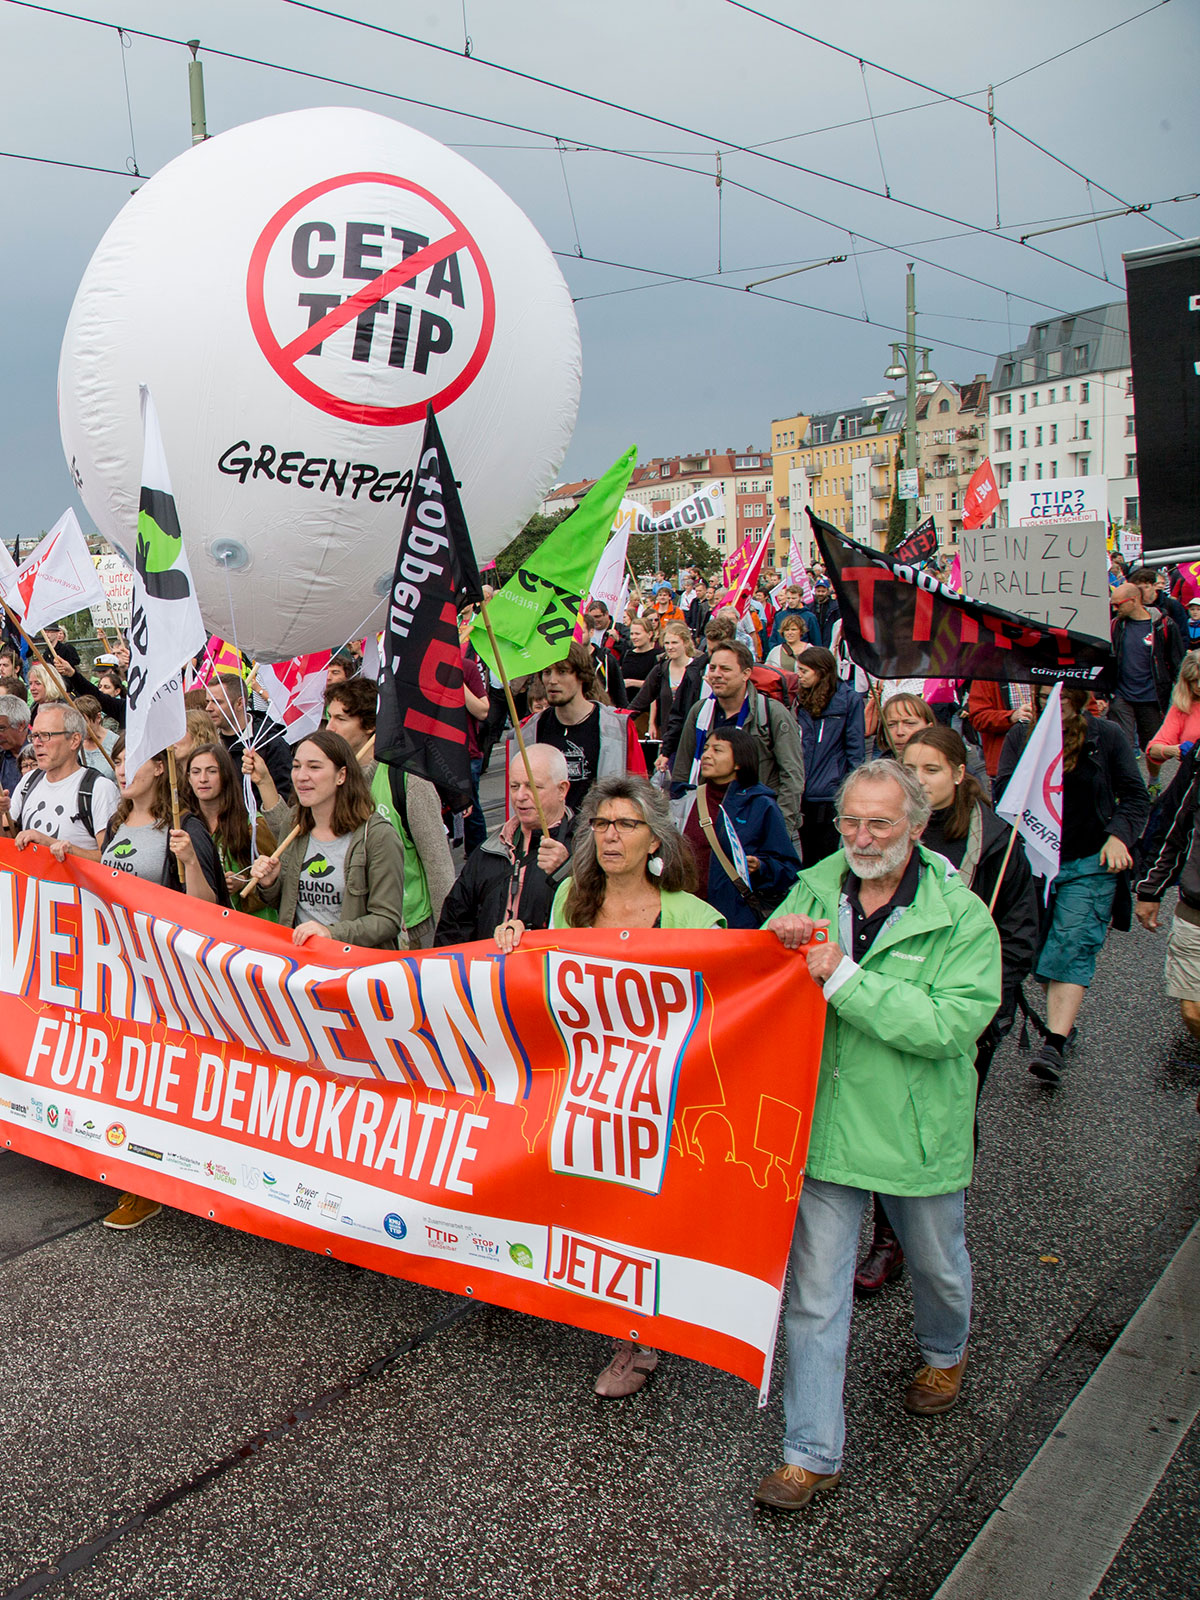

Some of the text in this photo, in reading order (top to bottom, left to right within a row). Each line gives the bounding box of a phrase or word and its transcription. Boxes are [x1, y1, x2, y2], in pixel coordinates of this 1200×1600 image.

[291, 221, 466, 310] CETA
[297, 293, 454, 375] TTIP
[217, 440, 462, 508] GREENPEA
[1030, 489, 1085, 505] TTIP?
[1030, 503, 1085, 518] CETA?
[963, 533, 1089, 563] NEIN ZU
[964, 570, 1102, 598] PARALLEL
[299, 880, 335, 893] BUND
[299, 891, 343, 906] ugend
[558, 957, 688, 1042] STOP
[568, 1034, 664, 1116] CETA
[0, 1097, 27, 1114] foodwatch
[24, 1009, 490, 1196] FÜR DIE DEMOKRATIE
[562, 1108, 661, 1182] TTIP
[214, 1173, 237, 1186] JUGEND
[296, 1183, 319, 1198] Power
[293, 1195, 312, 1210] Shift
[424, 1225, 459, 1243] TTIP
[472, 1237, 494, 1247] STOP
[552, 1235, 653, 1309] JETZT
